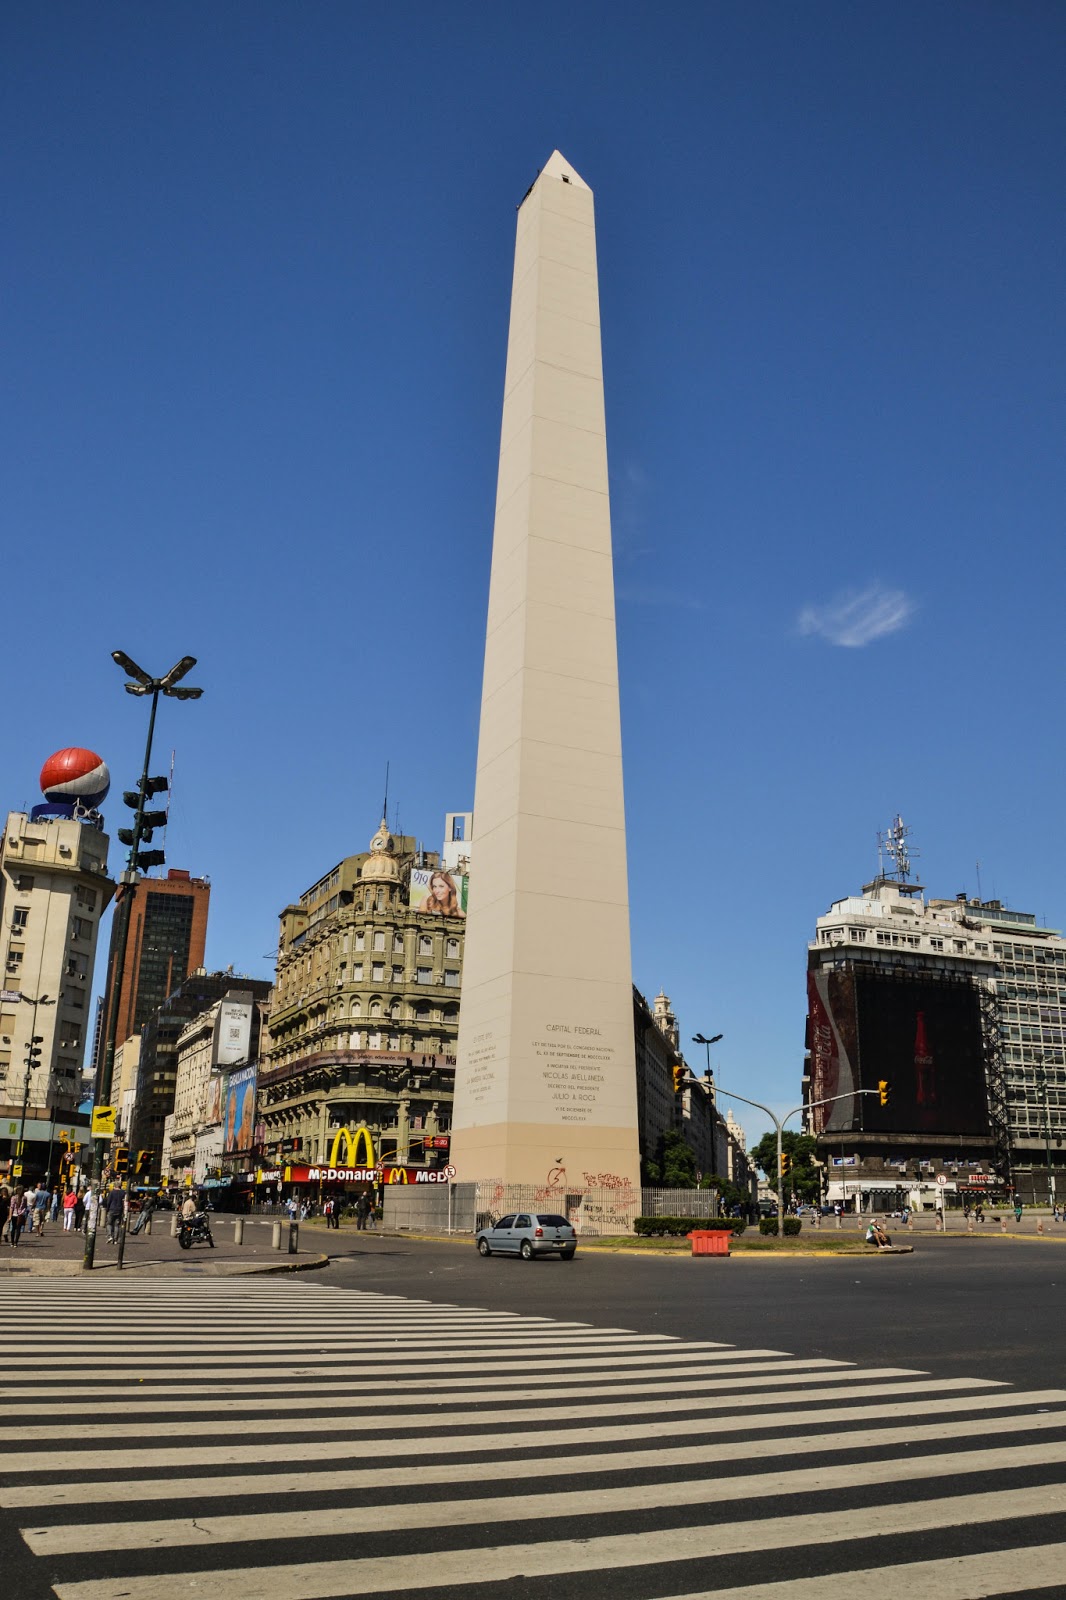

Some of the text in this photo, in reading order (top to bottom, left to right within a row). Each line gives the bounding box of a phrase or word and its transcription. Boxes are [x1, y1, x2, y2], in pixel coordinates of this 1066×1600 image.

[546, 1024, 602, 1036] CAPITAL FEDERAL
[308, 1169, 378, 1180] McDonald'
